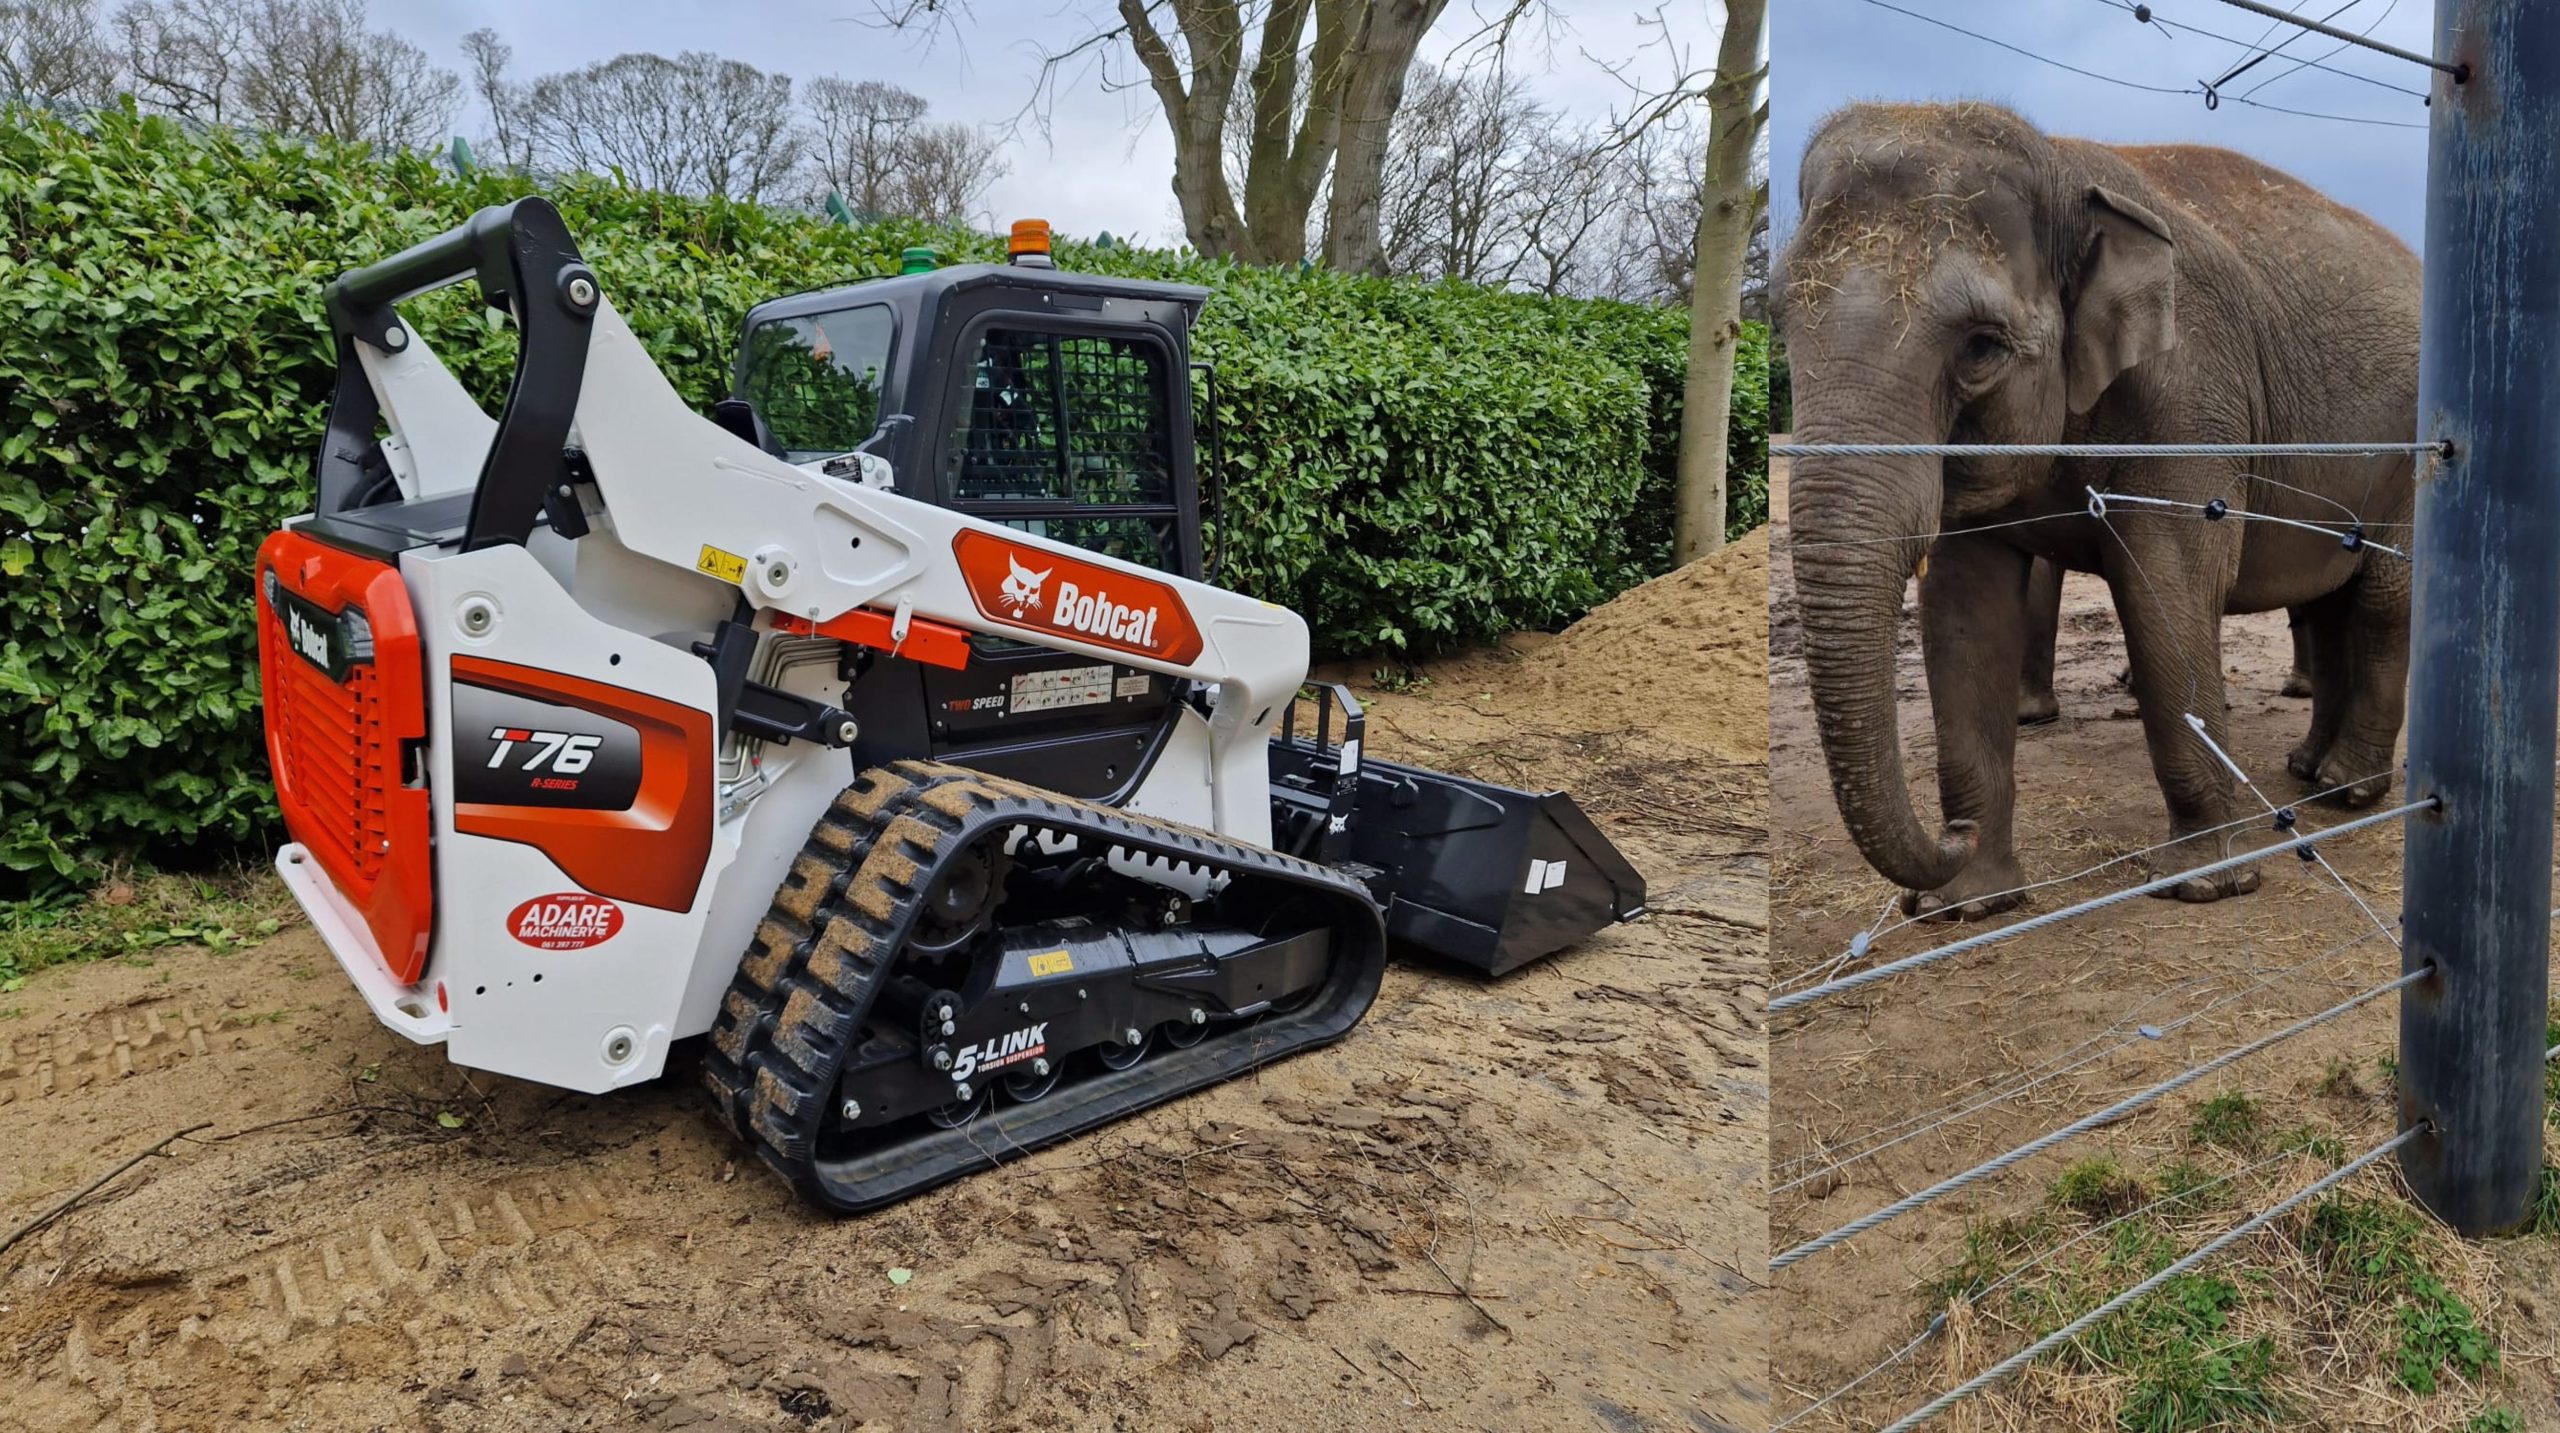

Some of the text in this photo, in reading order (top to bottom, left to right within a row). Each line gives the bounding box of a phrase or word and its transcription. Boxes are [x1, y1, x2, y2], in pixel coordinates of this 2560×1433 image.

[1053, 581, 1157, 647] Bobcat
[300, 618, 330, 669] Bobcat
[949, 695, 1005, 710] TWO SPEED
[487, 728, 602, 773] T76
[530, 777, 578, 790] R-SERIES
[520, 903, 615, 926] ADARE
[519, 926, 597, 938] MACHINERY
[951, 1022, 1049, 1081] 5-LINK
[977, 1045, 1045, 1073] TORSION SUSPENSION
